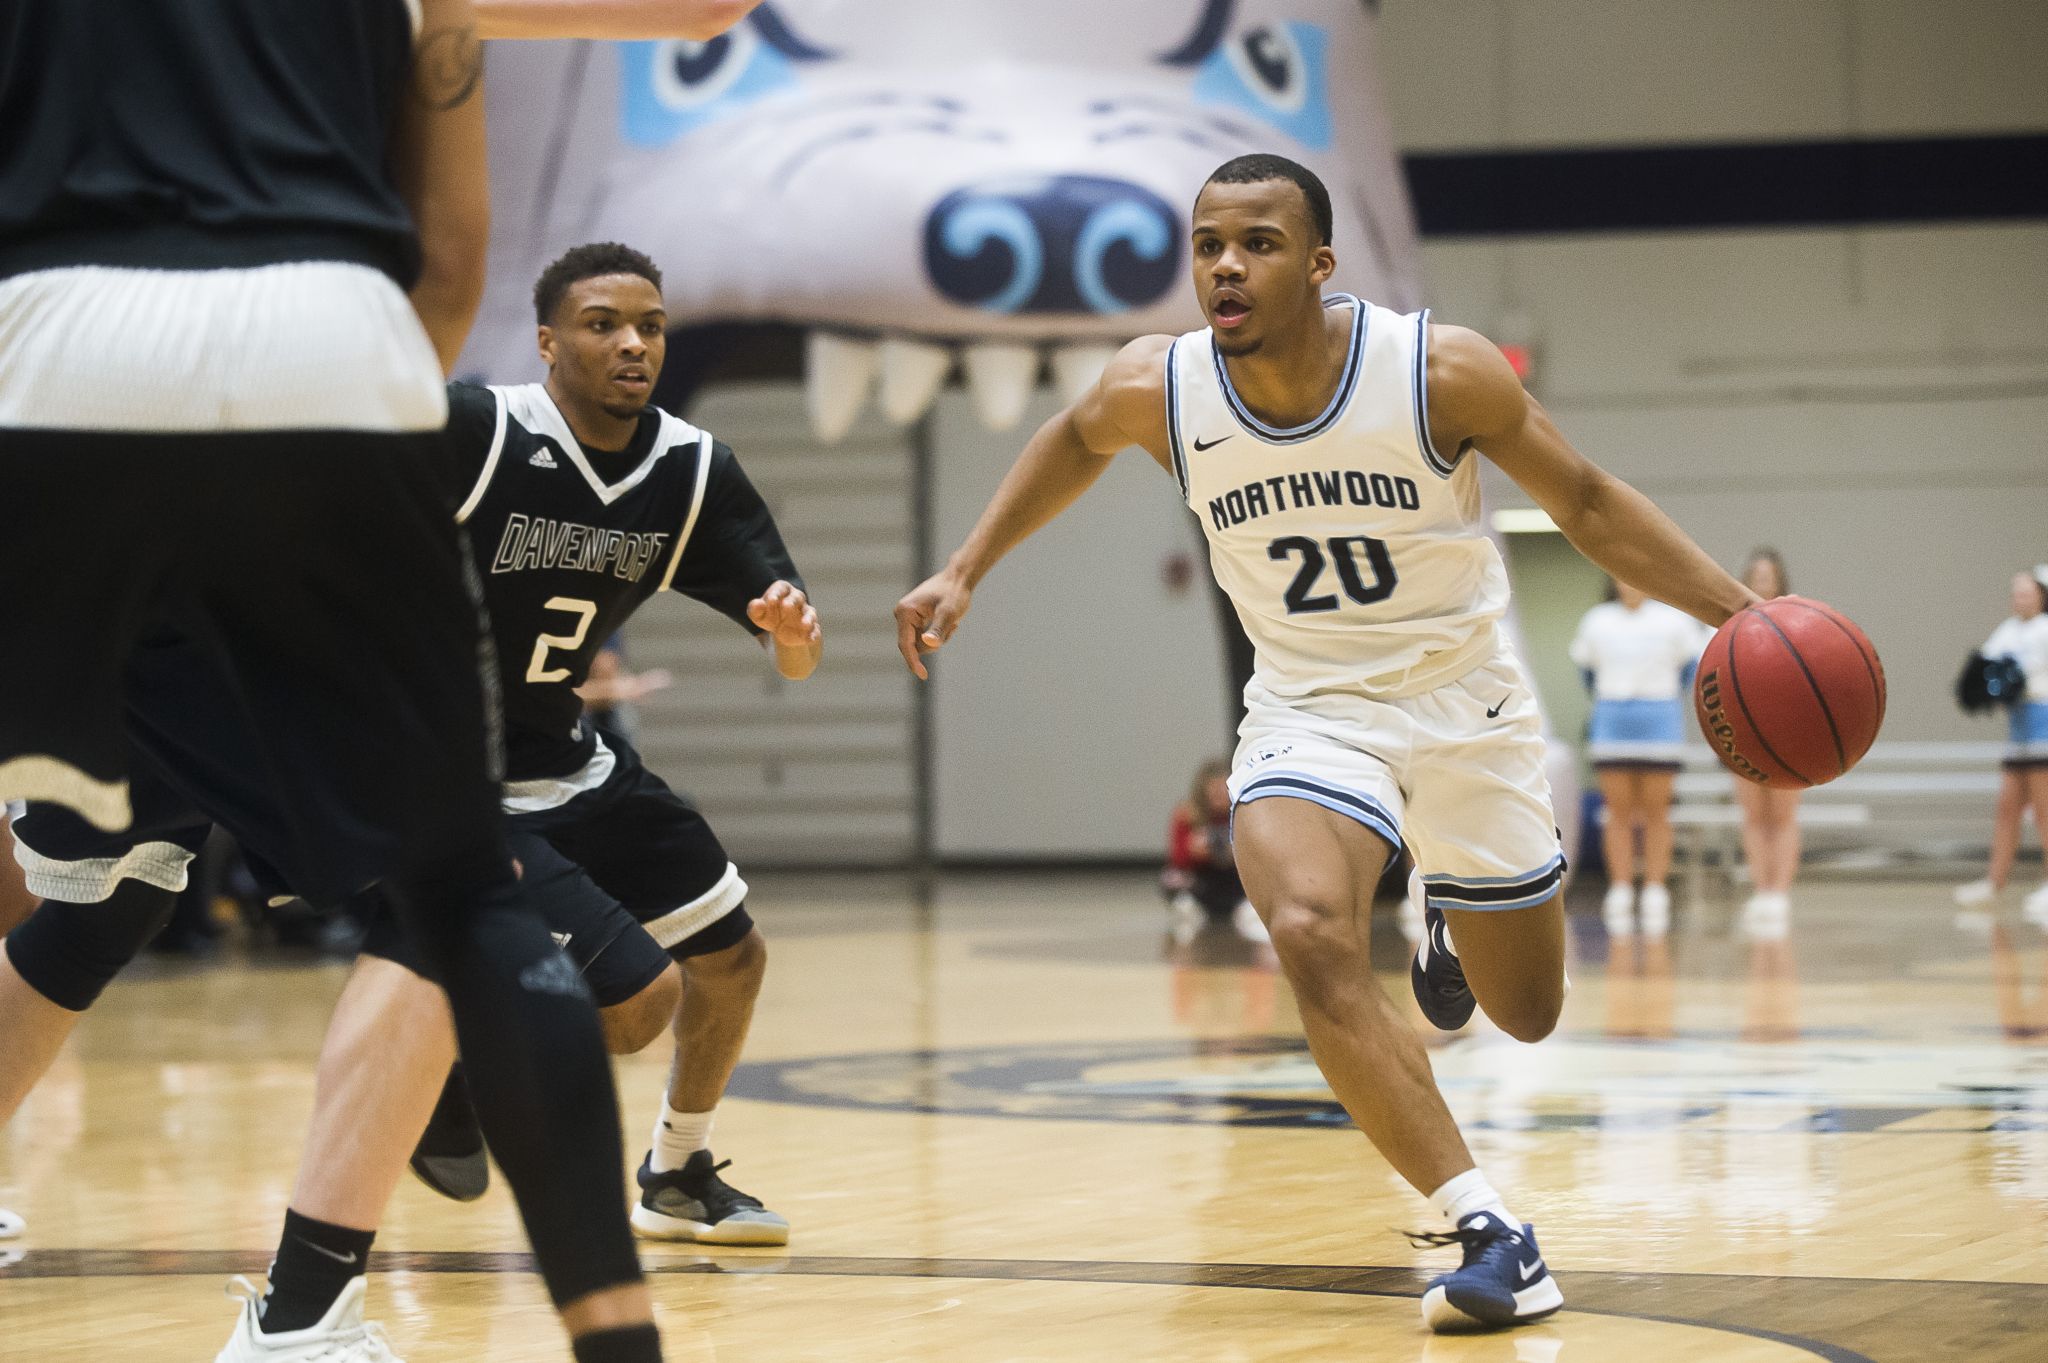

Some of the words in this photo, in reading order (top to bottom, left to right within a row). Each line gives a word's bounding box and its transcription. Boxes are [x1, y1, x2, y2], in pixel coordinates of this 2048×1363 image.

[1208, 470, 1420, 531] NORTHWOOD
[491, 512, 669, 582] DAVENPORT
[1266, 535, 1399, 615] 20
[526, 597, 597, 683] 2
